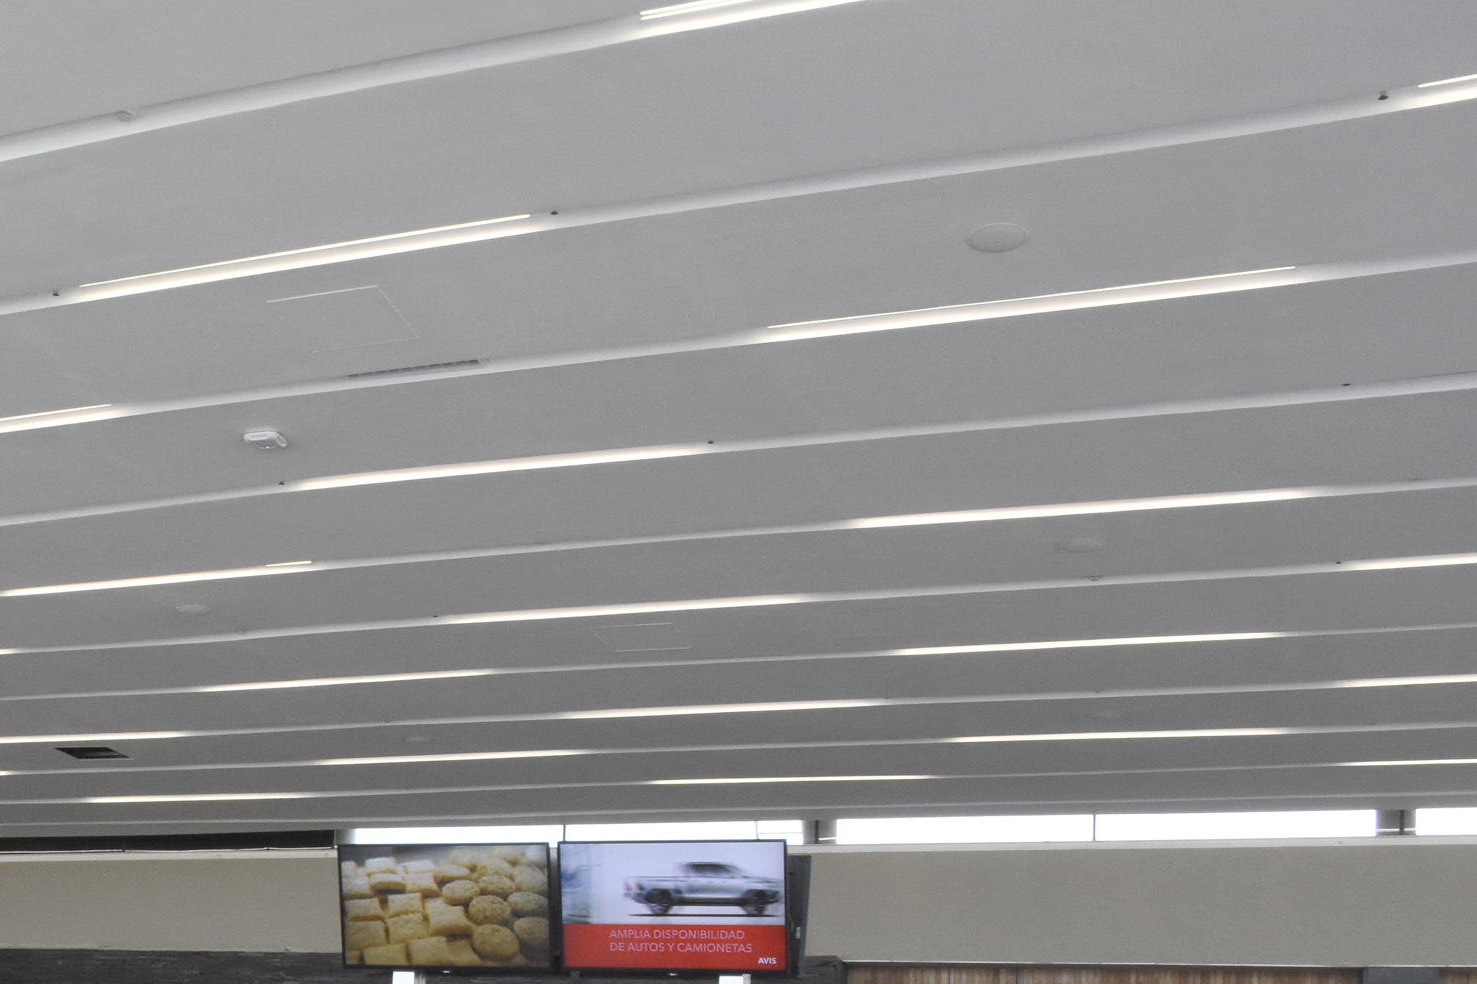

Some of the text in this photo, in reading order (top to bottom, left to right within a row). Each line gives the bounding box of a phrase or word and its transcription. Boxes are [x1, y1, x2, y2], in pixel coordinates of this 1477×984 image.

[609, 929, 746, 940] AMPLIA DISPONIBILIDAD
[609, 942, 753, 953] DE AUTOS Y CAMIONETAS
[757, 957, 777, 965] AVIS
